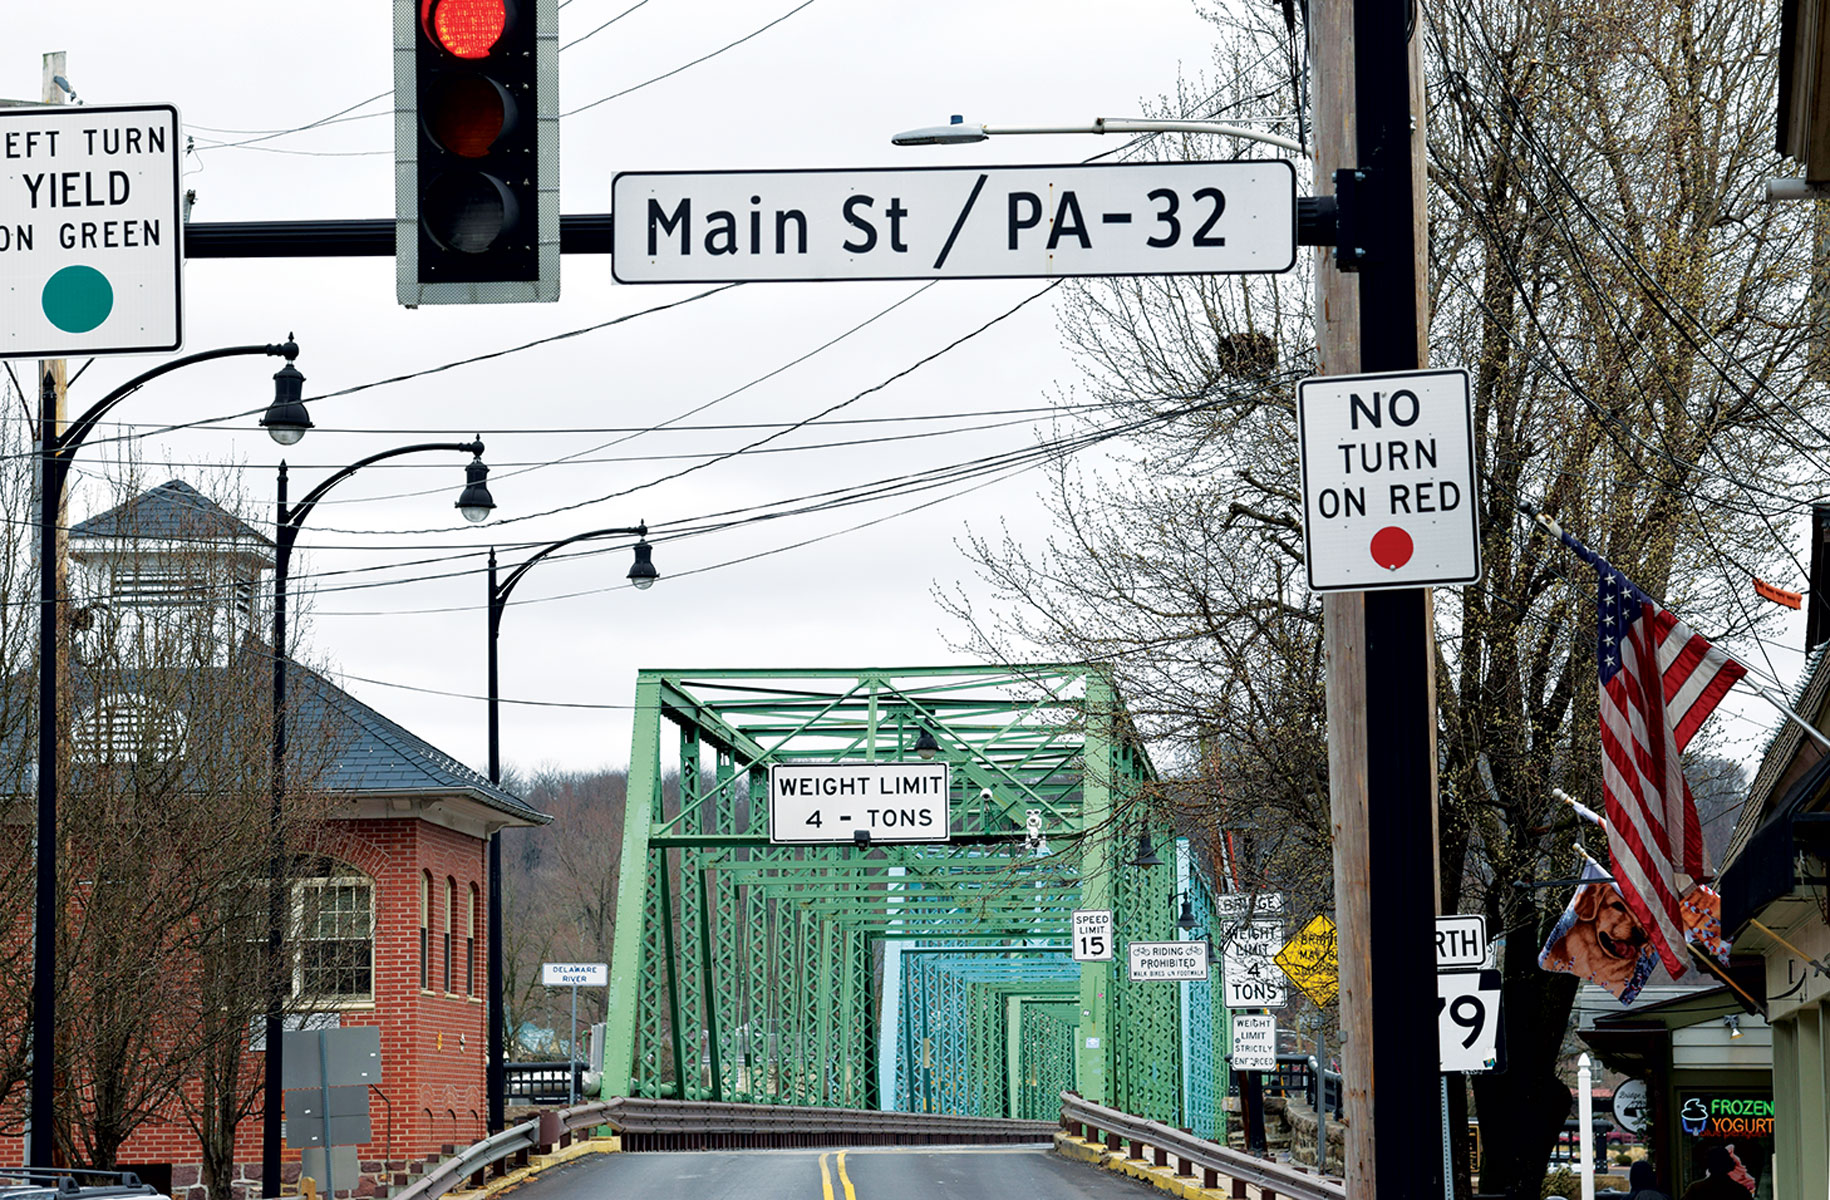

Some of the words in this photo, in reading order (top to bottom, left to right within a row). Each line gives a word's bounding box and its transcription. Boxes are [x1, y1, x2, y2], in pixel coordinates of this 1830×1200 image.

[5, 130, 60, 159] EFT
[83, 126, 165, 156] TURN
[22, 170, 130, 209] YIELD
[647, 195, 808, 256] Main
[841, 193, 909, 255] St
[932, 173, 989, 270] /
[1007, 186, 1227, 251] PA-32
[0, 224, 33, 252] ON
[59, 219, 160, 250] GREEN
[1349, 389, 1421, 431] NO
[1338, 438, 1437, 475] TURN
[1318, 486, 1366, 519] ON
[1389, 481, 1461, 515] RED
[779, 776, 870, 797] WEIGHT
[880, 776, 943, 796] LIMIT
[805, 809, 823, 829] 4
[866, 808, 933, 828] TONS
[1076, 915, 1109, 925] SPEED
[1079, 925, 1106, 935] LIMIT
[1080, 936, 1105, 956] 15
[1152, 946, 1185, 957] RIDING
[1236, 943, 1269, 957] LIMIT
[1436, 930, 1478, 957] RTH
[552, 966, 598, 974] DELAWARE
[1140, 958, 1196, 969] PROHIBITED
[1247, 963, 1260, 977] 4
[562, 975, 588, 983] RIVER
[1133, 970, 1147, 978] WALK
[1177, 969, 1204, 977] FOOTWALK
[1231, 982, 1278, 1001] TONS
[1236, 1019, 1271, 1028] WEIGHT
[1444, 994, 1486, 1050] 9
[1241, 1031, 1266, 1040] LIMIT
[1235, 1044, 1273, 1053] STRICTLY
[1234, 1057, 1274, 1066] ENFORCED
[1711, 1099, 1775, 1116] FROZEN
[1711, 1117, 1775, 1133] YOGURT
